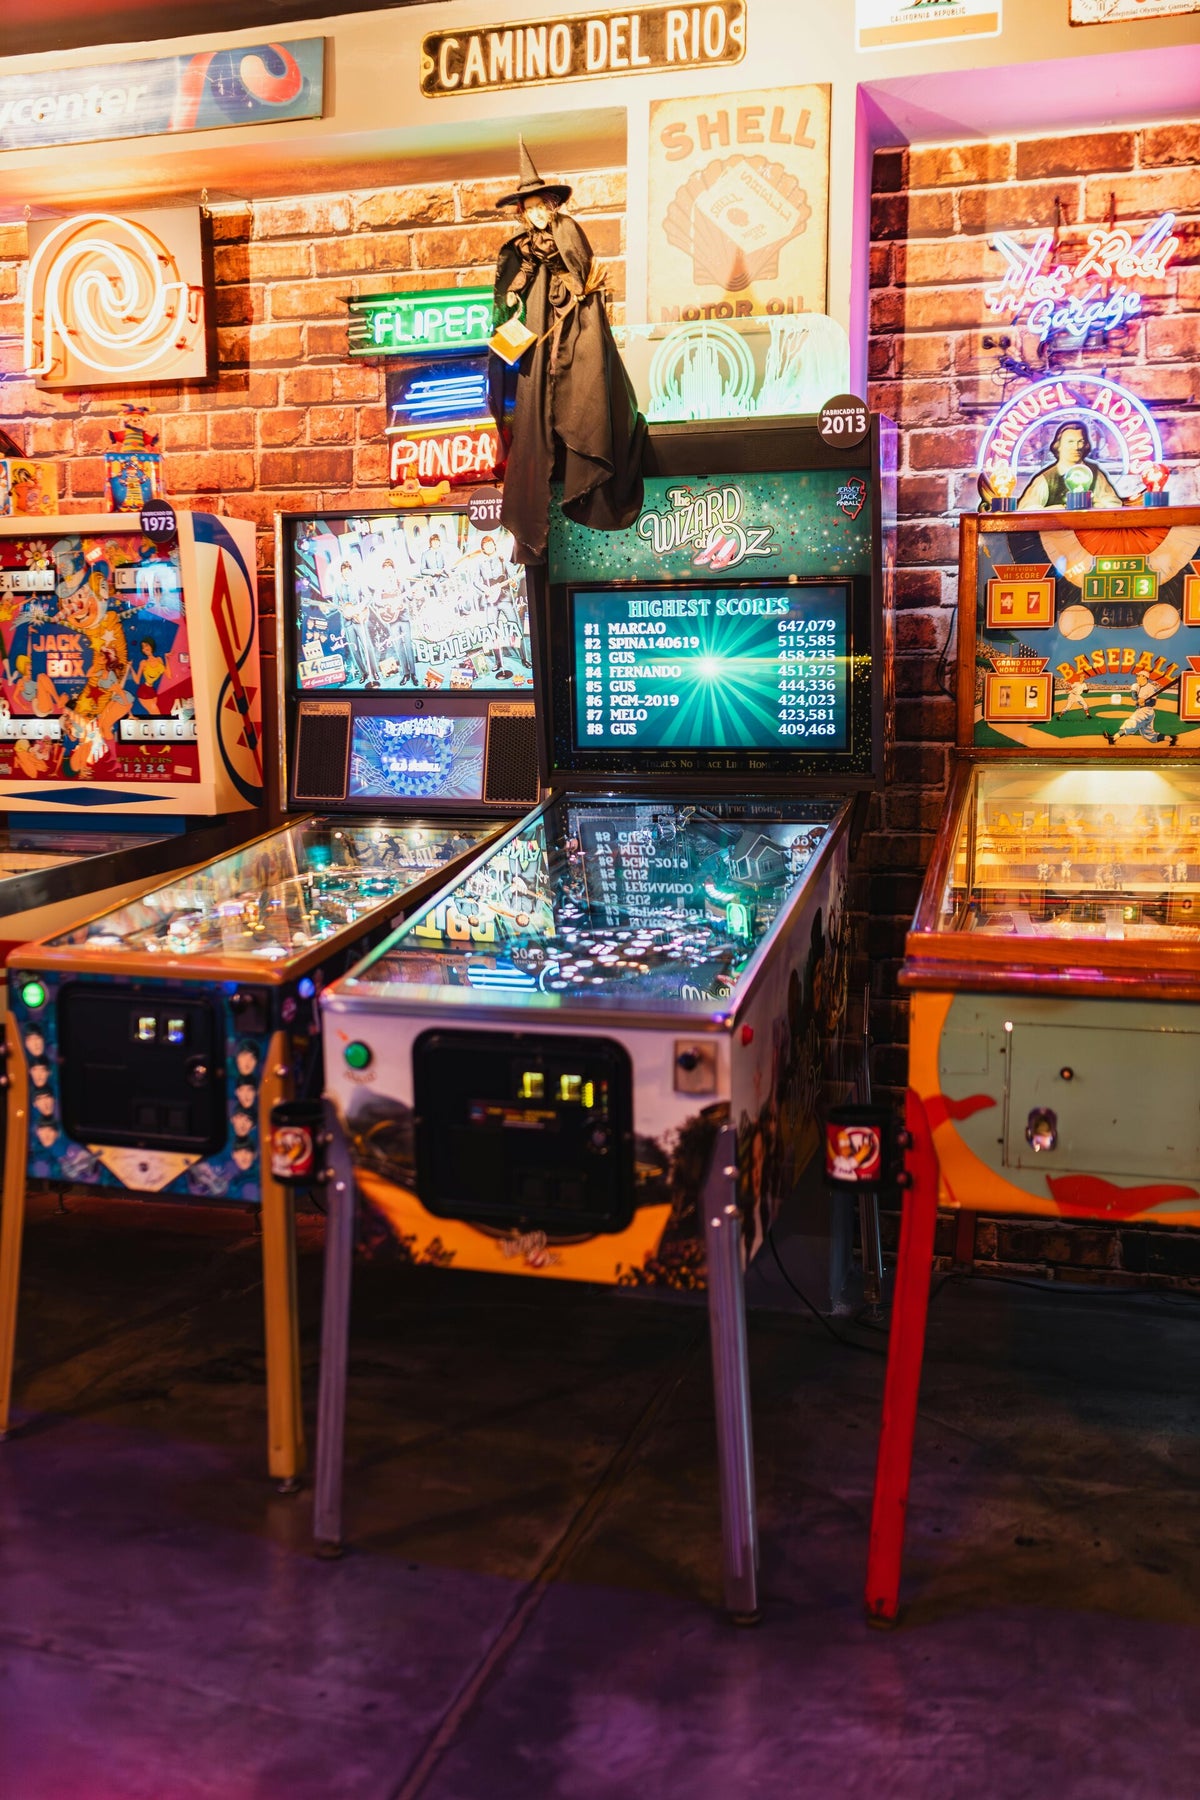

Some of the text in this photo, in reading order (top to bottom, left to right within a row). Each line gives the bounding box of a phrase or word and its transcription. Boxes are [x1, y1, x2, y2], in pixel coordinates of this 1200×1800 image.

[890, 6, 966, 23] CALIFORNIA REPUBLIC
[438, 5, 727, 88] CAMINO DEL RIO
[660, 105, 816, 162] SHELL
[660, 295, 812, 323] MOTOR OIL
[1028, 283, 1142, 340] Garage
[374, 304, 493, 344] FLIPER
[822, 408, 855, 416] FABRICADO
[821, 414, 866, 434] 2013
[986, 382, 1156, 476] SAMUEL ADAMS
[836, 486, 860, 494] JERSEY
[839, 493, 858, 501] JACK
[142, 516, 175, 531] 1973
[640, 487, 741, 553] WIZARD
[1101, 561, 1137, 571] OUTS
[1016, 571, 1041, 579] SCORE
[1092, 579, 1149, 595] 1 2 3
[628, 597, 790, 618] HIGHEST SCORES
[1001, 593, 1040, 609] 4 7
[584, 619, 836, 635] #1 MARCAO 647,079
[33, 634, 84, 652] JACK
[416, 617, 523, 666] BEATLEMANIA
[584, 634, 836, 649] #2 SPINA140619 515,585
[585, 649, 836, 664] #3 GUS 458,735
[996, 659, 1043, 667] GRAND SLAM
[1056, 647, 1180, 682] BASEBALL
[47, 659, 86, 678] BOX
[585, 664, 836, 678] #4 FERNANDO 451,375
[586, 679, 836, 693] #5 GUS 444,336
[1028, 686, 1039, 699] 5
[586, 694, 836, 708] #6 PGM-2019 424,023
[586, 708, 835, 722] #7 MELO 423,581
[587, 722, 836, 737] #8 GUS 409,468
[123, 763, 166, 773] 1 2 3 4
